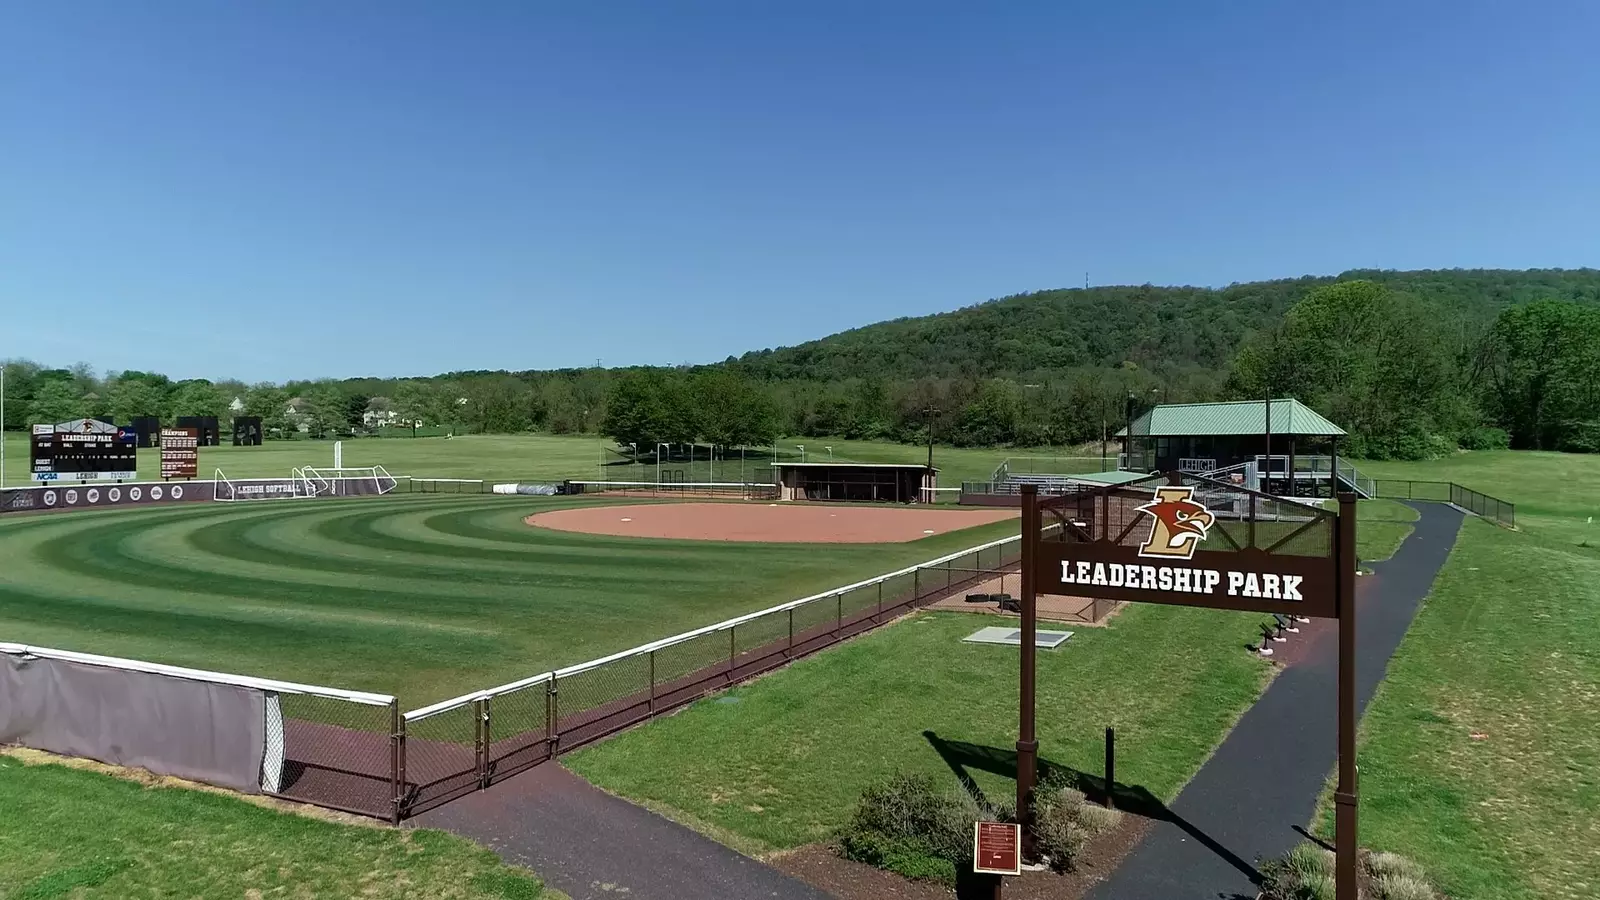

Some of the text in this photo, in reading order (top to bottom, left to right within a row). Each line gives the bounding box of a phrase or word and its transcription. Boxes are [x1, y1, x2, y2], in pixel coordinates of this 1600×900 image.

[61, 434, 97, 442] LEADERSHIP
[1181, 460, 1214, 471] LEHIGH
[238, 484, 301, 494] LEHIGH SOFTBALL
[1061, 560, 1304, 601] LEADERSHIP PARK
